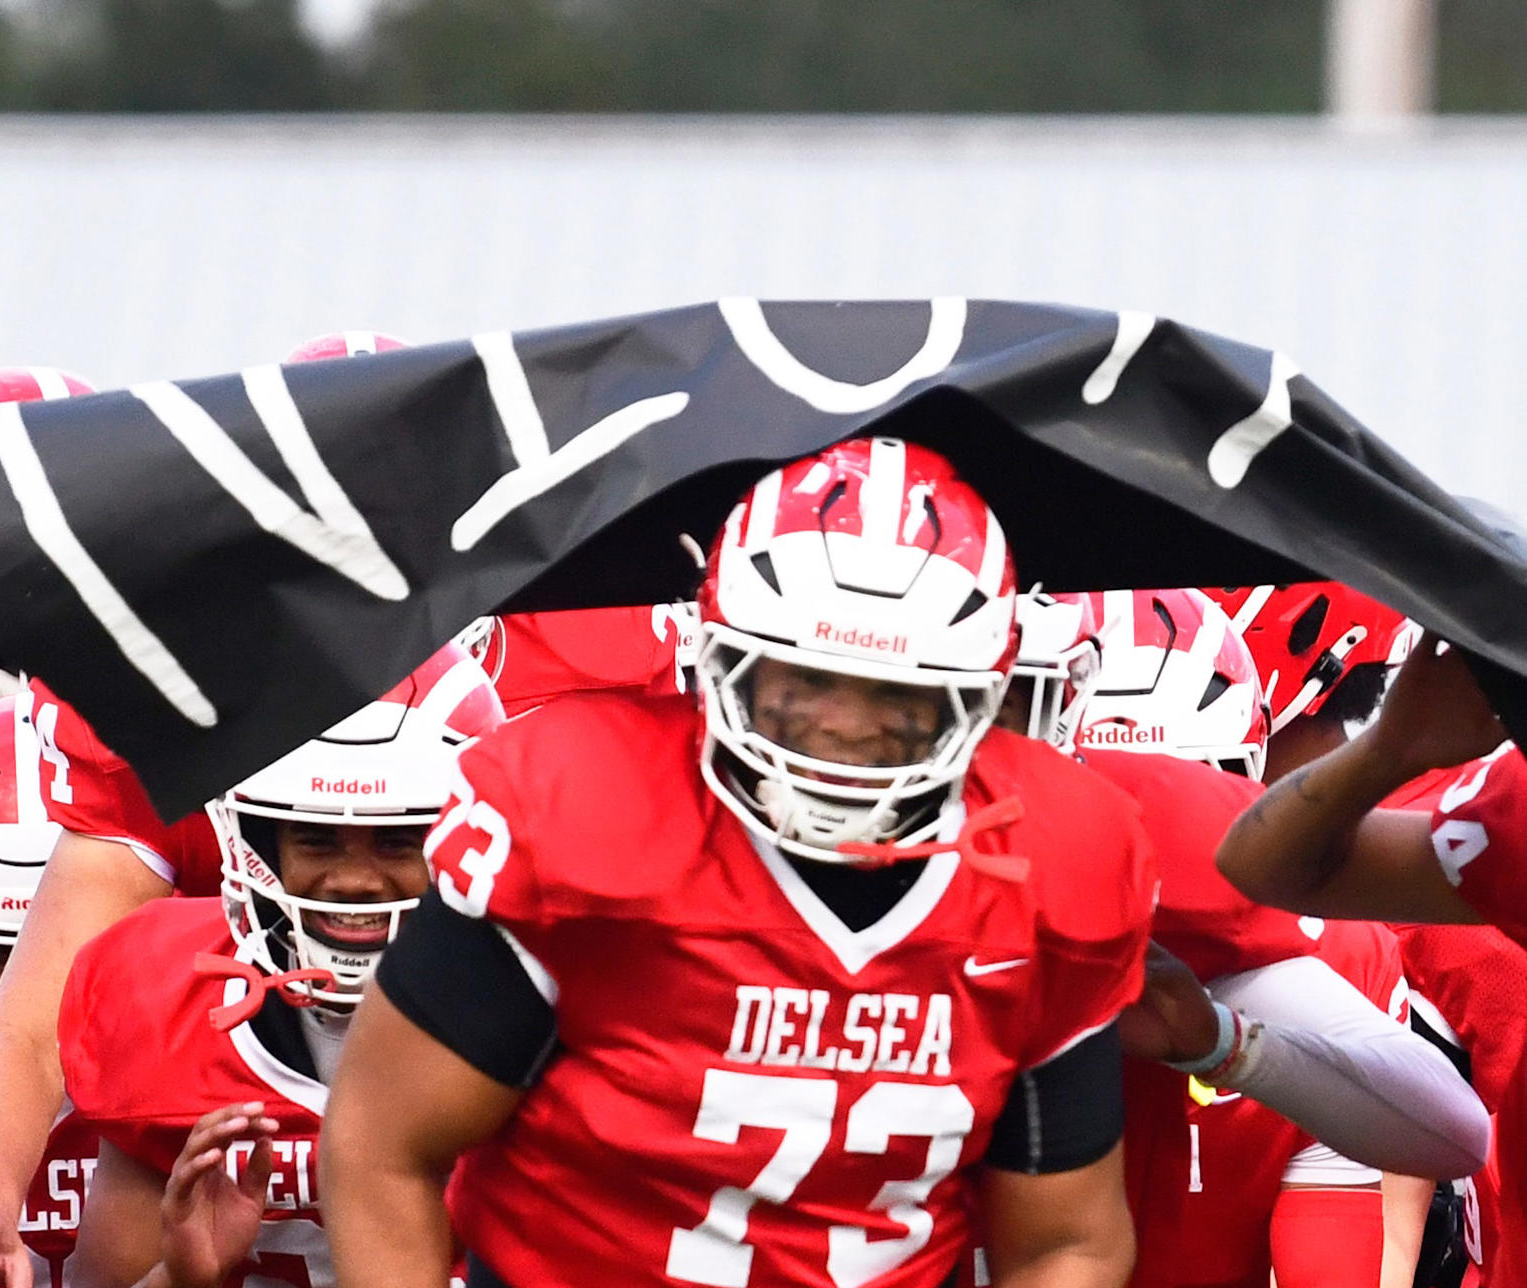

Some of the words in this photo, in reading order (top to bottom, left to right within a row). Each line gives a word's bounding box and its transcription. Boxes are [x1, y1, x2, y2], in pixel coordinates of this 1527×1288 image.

[815, 621, 908, 654] Riddell
[1081, 726, 1164, 743] Riddell
[311, 777, 386, 795] Riddell
[725, 985, 952, 1077] DELSEA
